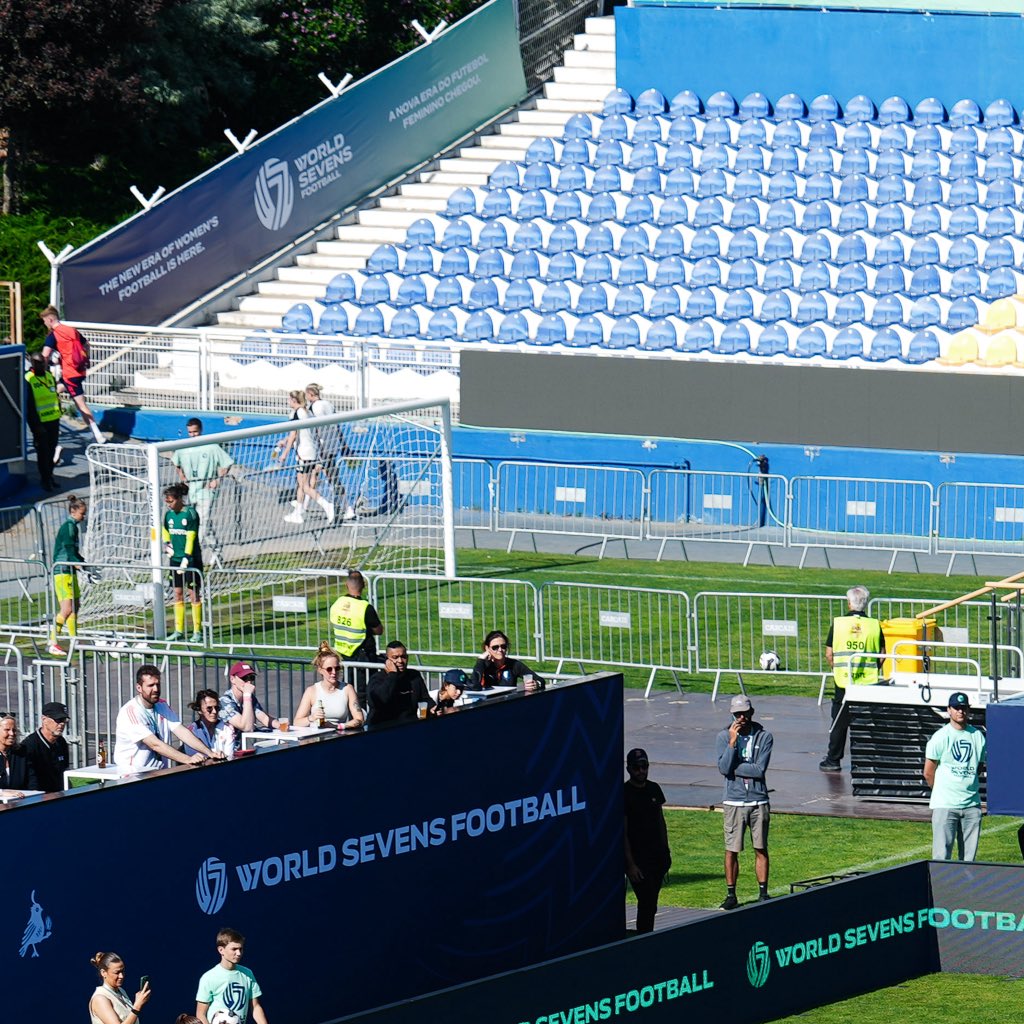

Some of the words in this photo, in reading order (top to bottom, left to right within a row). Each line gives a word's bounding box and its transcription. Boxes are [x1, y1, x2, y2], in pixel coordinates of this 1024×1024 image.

[388, 110, 396, 122] A
[395, 96, 420, 117] NOVA
[420, 85, 438, 102] ERA
[438, 77, 451, 92] DO
[451, 54, 489, 83] FUTEBOL
[402, 97, 444, 128] FEMININO
[294, 133, 345, 171] WORLD
[298, 146, 353, 188] SEVENS
[301, 170, 341, 199] FOOTBALL
[98, 276, 119, 295] THE
[119, 263, 141, 284] NEW
[141, 252, 162, 271] ERA
[161, 243, 175, 258] OF
[174, 216, 219, 249] WOMEN'S
[118, 265, 168, 301] FOOTBALL
[167, 258, 177, 271] IS
[177, 242, 206, 266] HERE.
[846, 640, 865, 650] 950
[235, 844, 337, 892] WORLD
[342, 817, 447, 867] SEVENS
[451, 785, 586, 841] FOOTBALL
[775, 932, 841, 968] WORLD
[844, 912, 915, 949] SEVENS
[614, 970, 714, 1015] FOOTBALL
